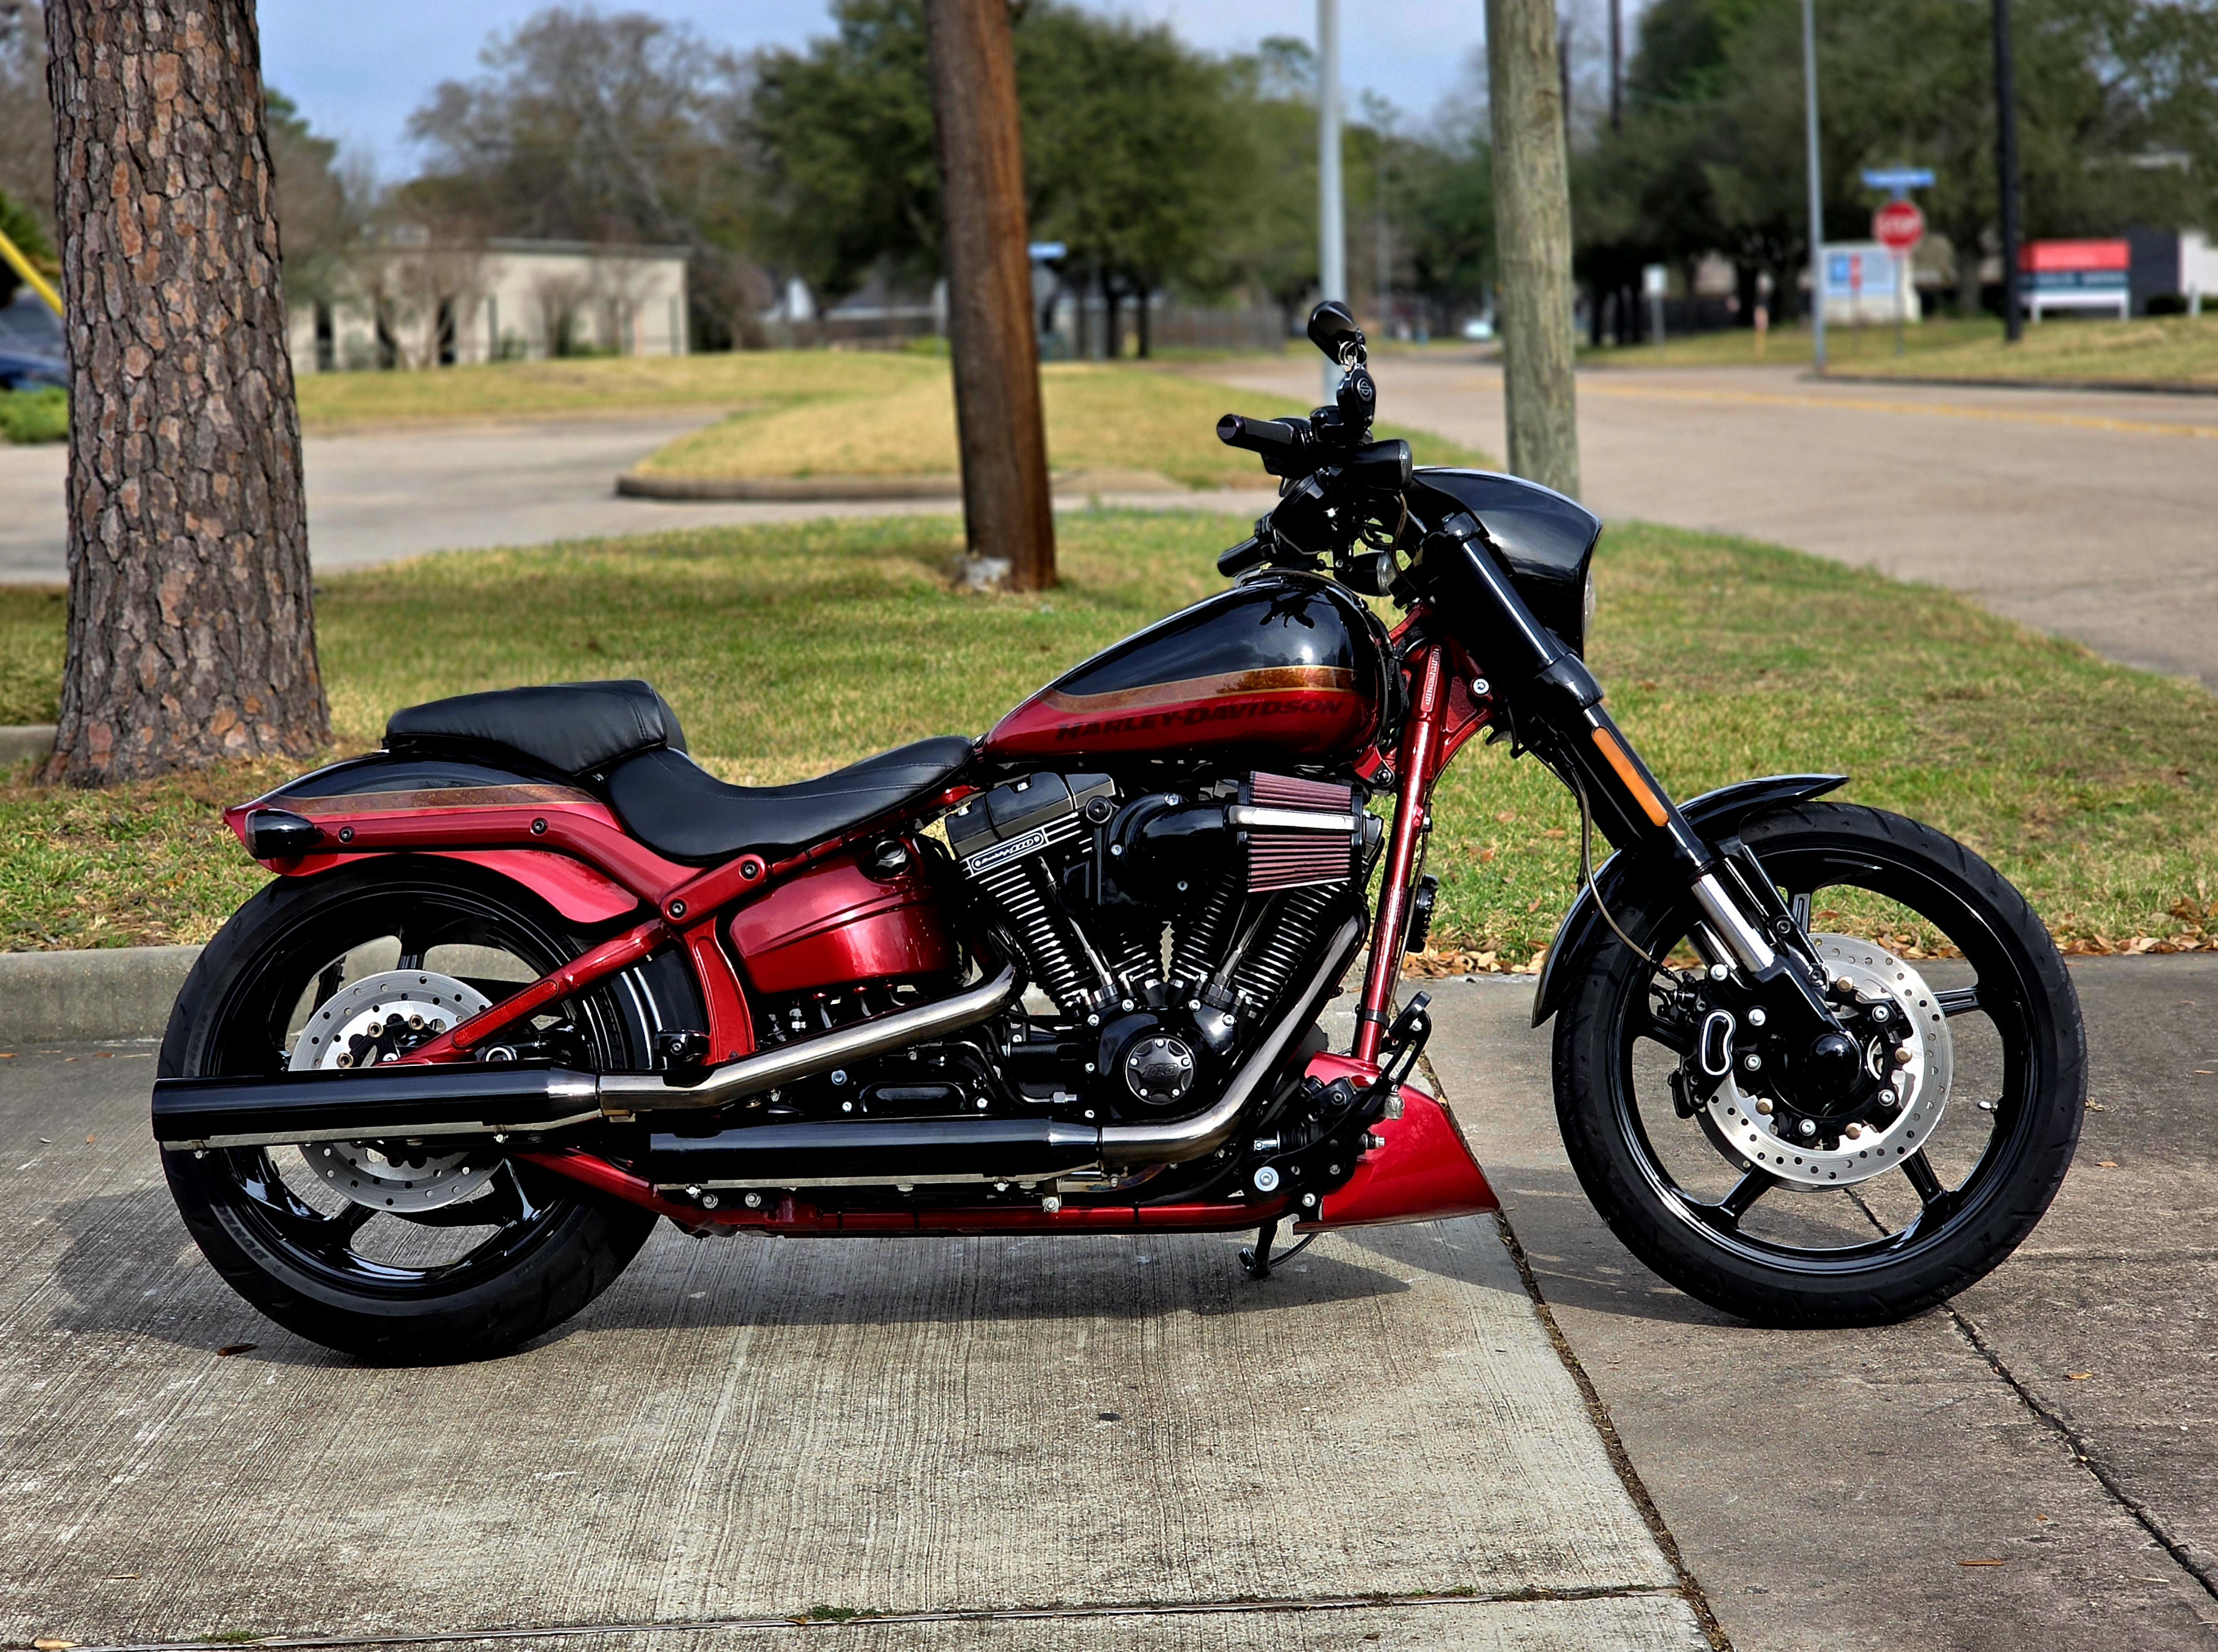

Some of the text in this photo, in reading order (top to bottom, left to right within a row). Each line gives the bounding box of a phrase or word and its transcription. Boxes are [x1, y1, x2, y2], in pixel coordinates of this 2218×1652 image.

[1055, 700, 1344, 741] HARLEY-DAVIDSON
[1142, 1063, 1178, 1077] 110
[215, 1203, 269, 1260] DUNLO
